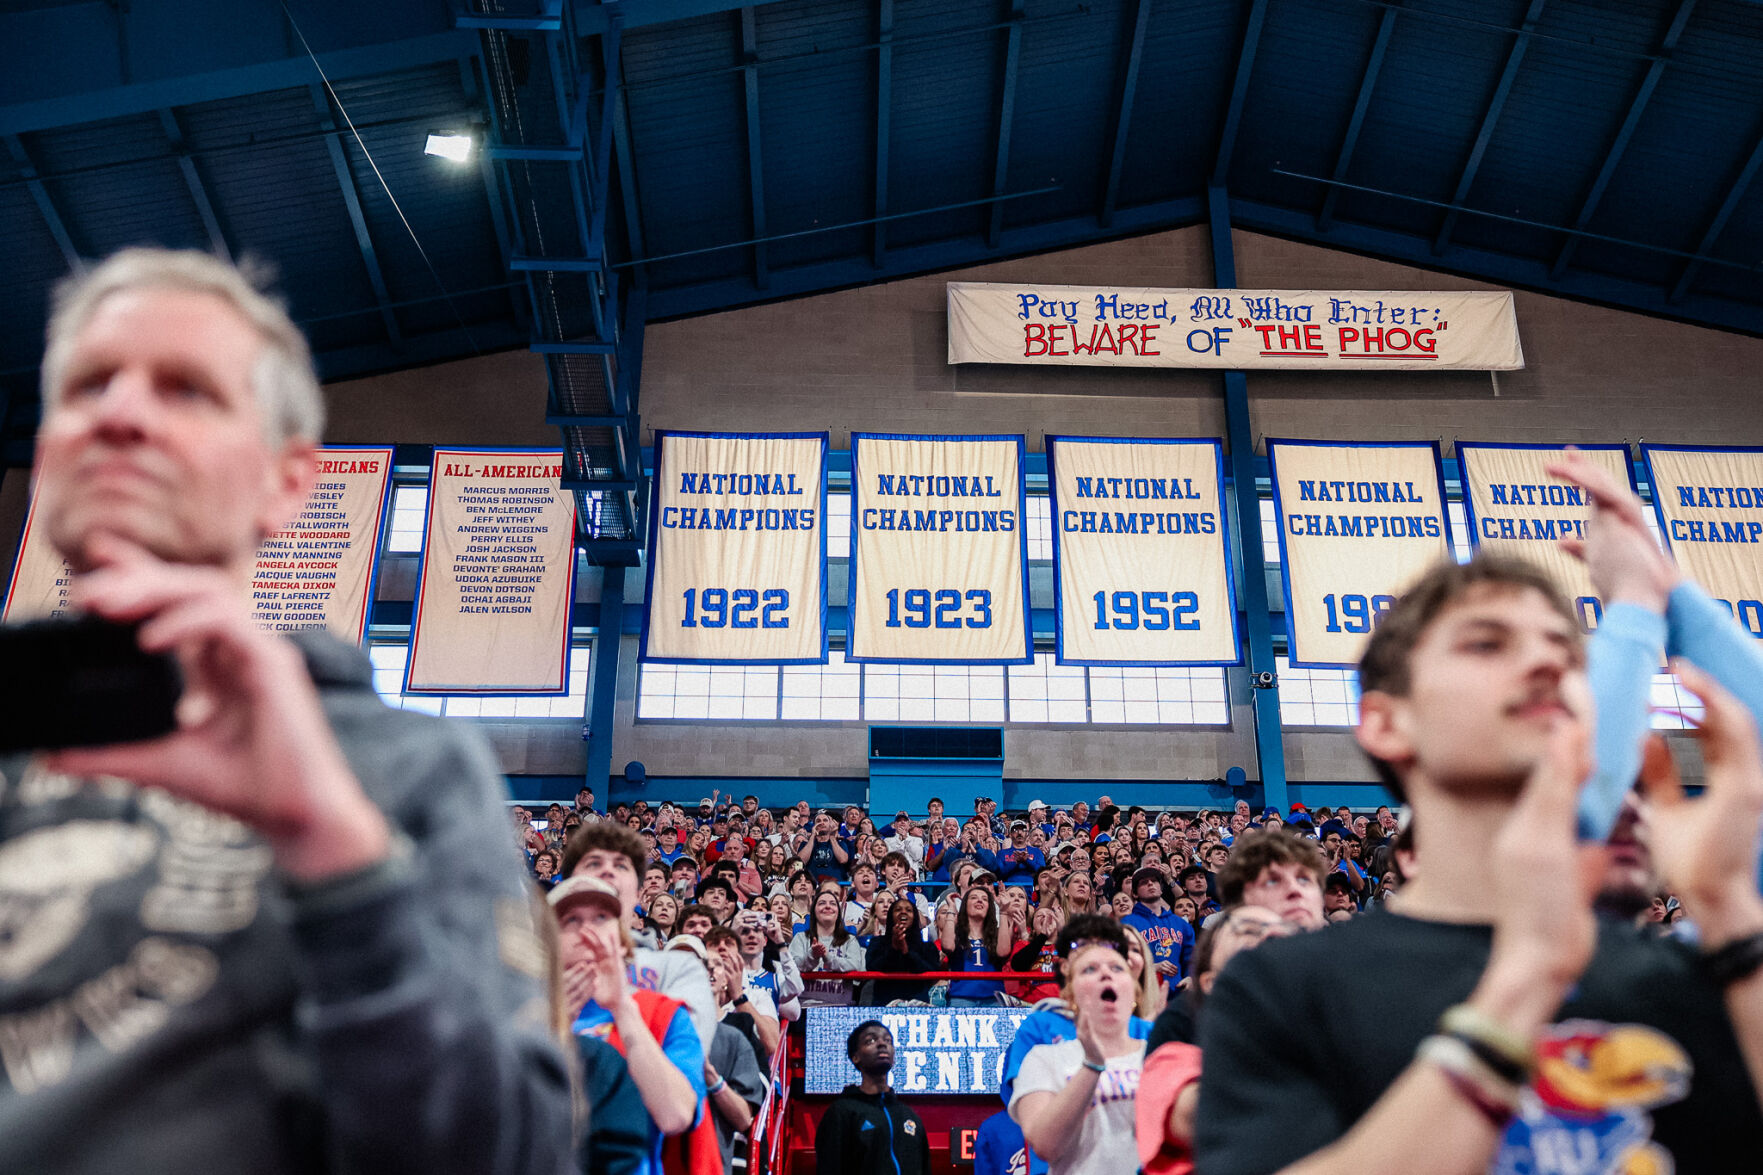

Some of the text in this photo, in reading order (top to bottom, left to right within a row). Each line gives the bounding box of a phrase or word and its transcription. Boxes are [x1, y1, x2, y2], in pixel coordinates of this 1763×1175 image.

[1017, 293, 1441, 326] Pay Heed, All Who Enter:
[1024, 323, 1160, 357] BEWARE
[1186, 327, 1233, 356] OF
[315, 461, 379, 473] ERICANS
[444, 464, 561, 478] ALL-AMERICAN
[680, 473, 802, 495] NATIONAL
[878, 474, 1001, 497] NATIONAL
[1076, 477, 1200, 499] NATIONAL
[1298, 480, 1423, 502] NATIONAL
[662, 508, 815, 530] CHAMPIONS
[863, 509, 1015, 532] CHAMPIONS
[1064, 510, 1216, 534] CHAMPIONS
[1289, 514, 1441, 537] CHAMPIONS
[1482, 517, 1590, 540] CHAMPI
[465, 545, 490, 553] JOSH
[252, 581, 300, 589] TAMECKA
[455, 575, 489, 583] UDOKA
[460, 585, 493, 593] DEVON
[257, 602, 282, 610] PAUL
[282, 592, 331, 600] LaFRENTZ
[682, 588, 789, 628] 1922
[886, 589, 992, 628] 1923
[1093, 591, 1201, 630] 1952
[1323, 594, 1400, 633] 198
[973, 948, 983, 967] 1
[882, 1014, 999, 1048] THANK
[888, 1051, 1006, 1091] ENI
